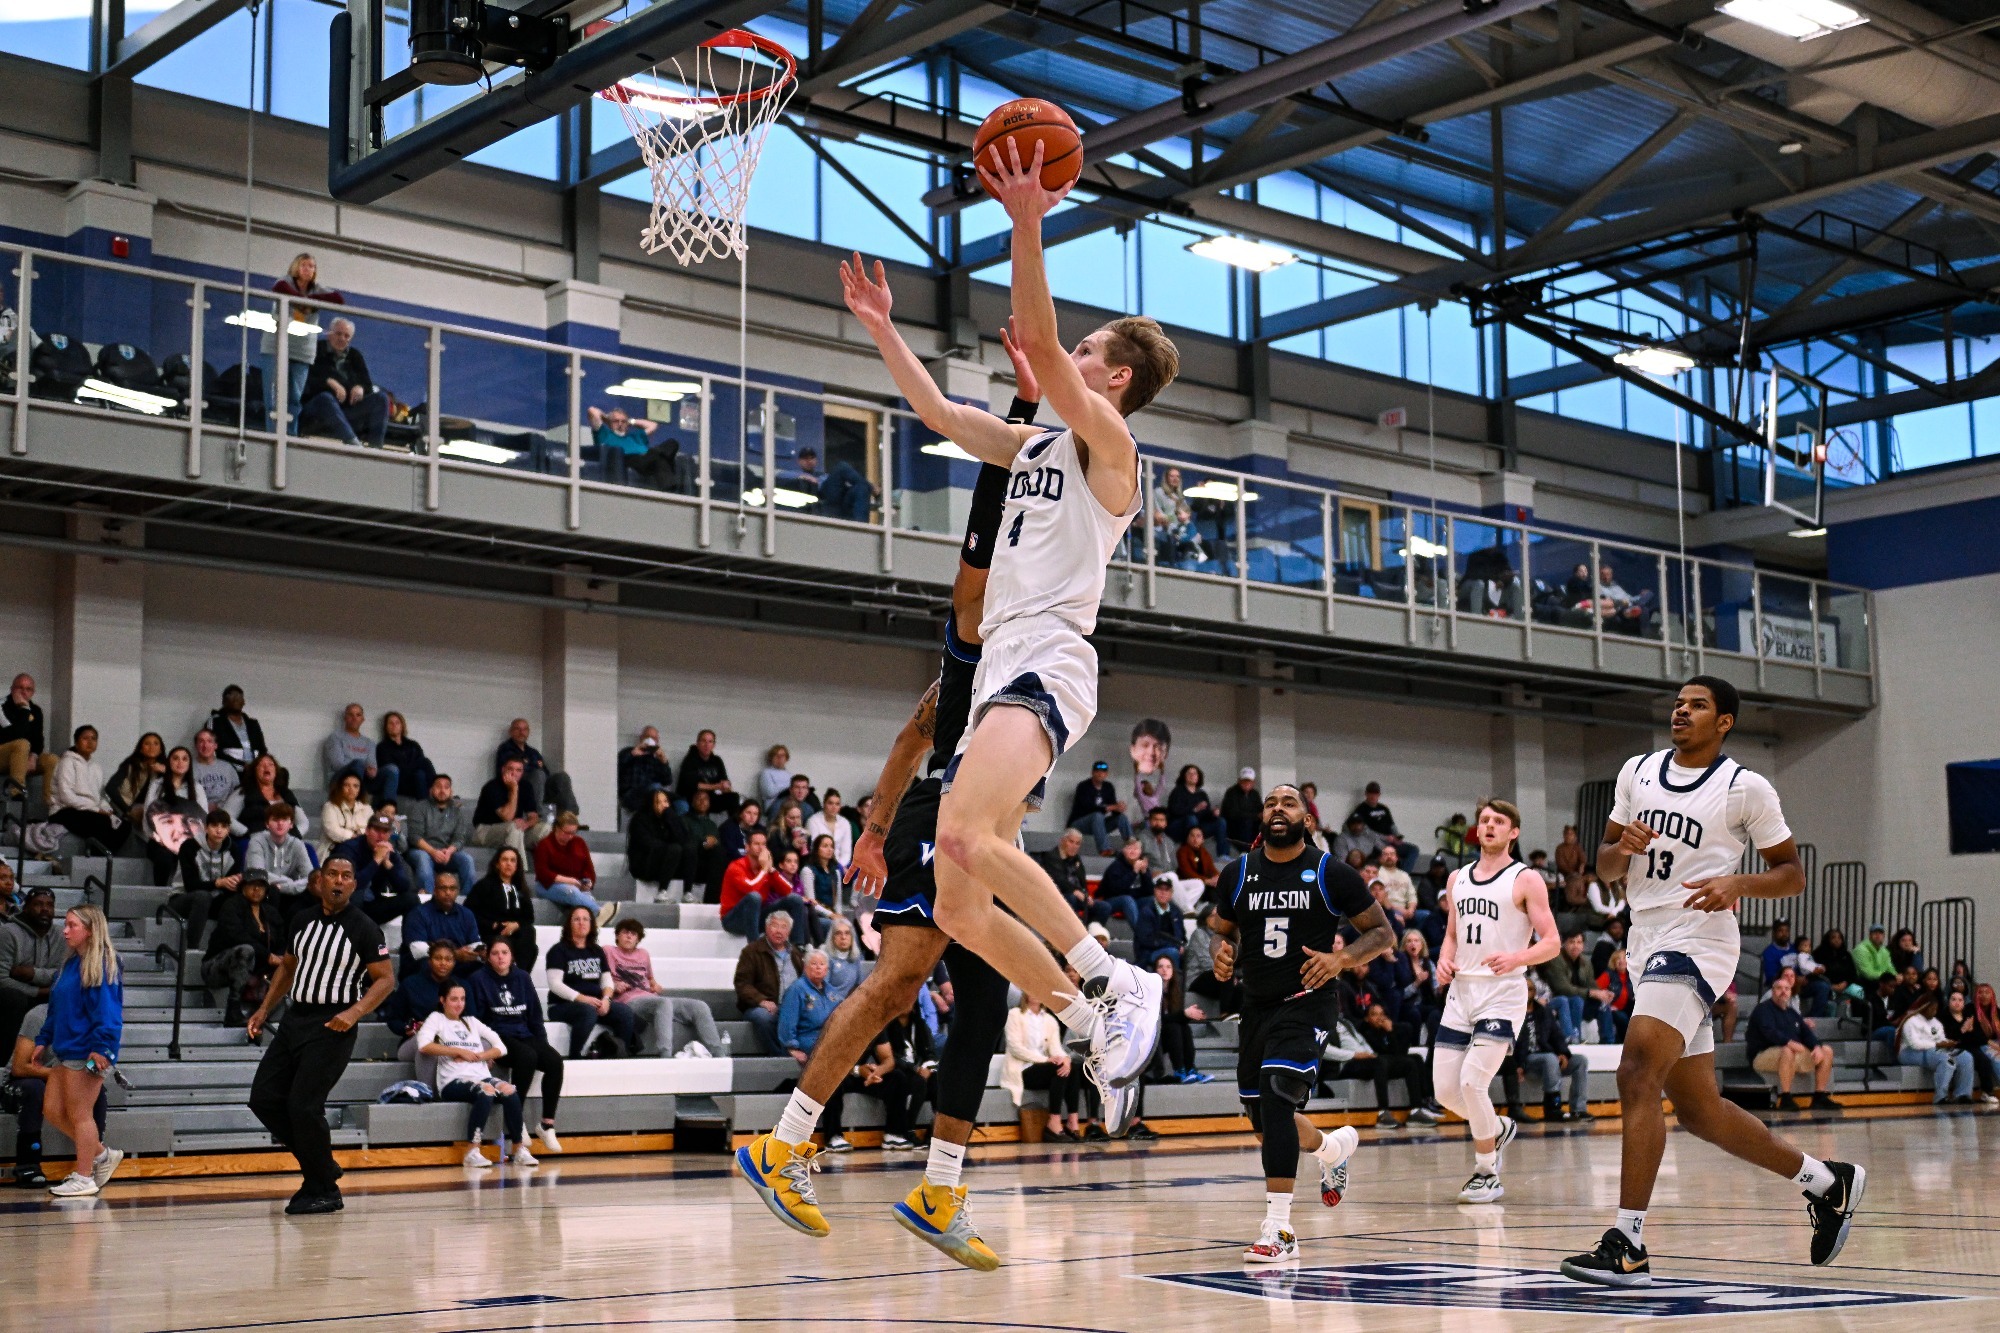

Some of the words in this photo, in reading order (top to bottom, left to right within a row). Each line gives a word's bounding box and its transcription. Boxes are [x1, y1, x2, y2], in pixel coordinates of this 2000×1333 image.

[1003, 112, 1034, 127] ROCK
[1007, 509, 1026, 548] 4
[1775, 641, 1827, 663] BLAZES
[1645, 848, 1675, 881] 13
[1248, 890, 1310, 911] WILSON
[1457, 897, 1499, 921] HOOD
[1263, 916, 1290, 959] 5
[1466, 923, 1482, 945] 11
